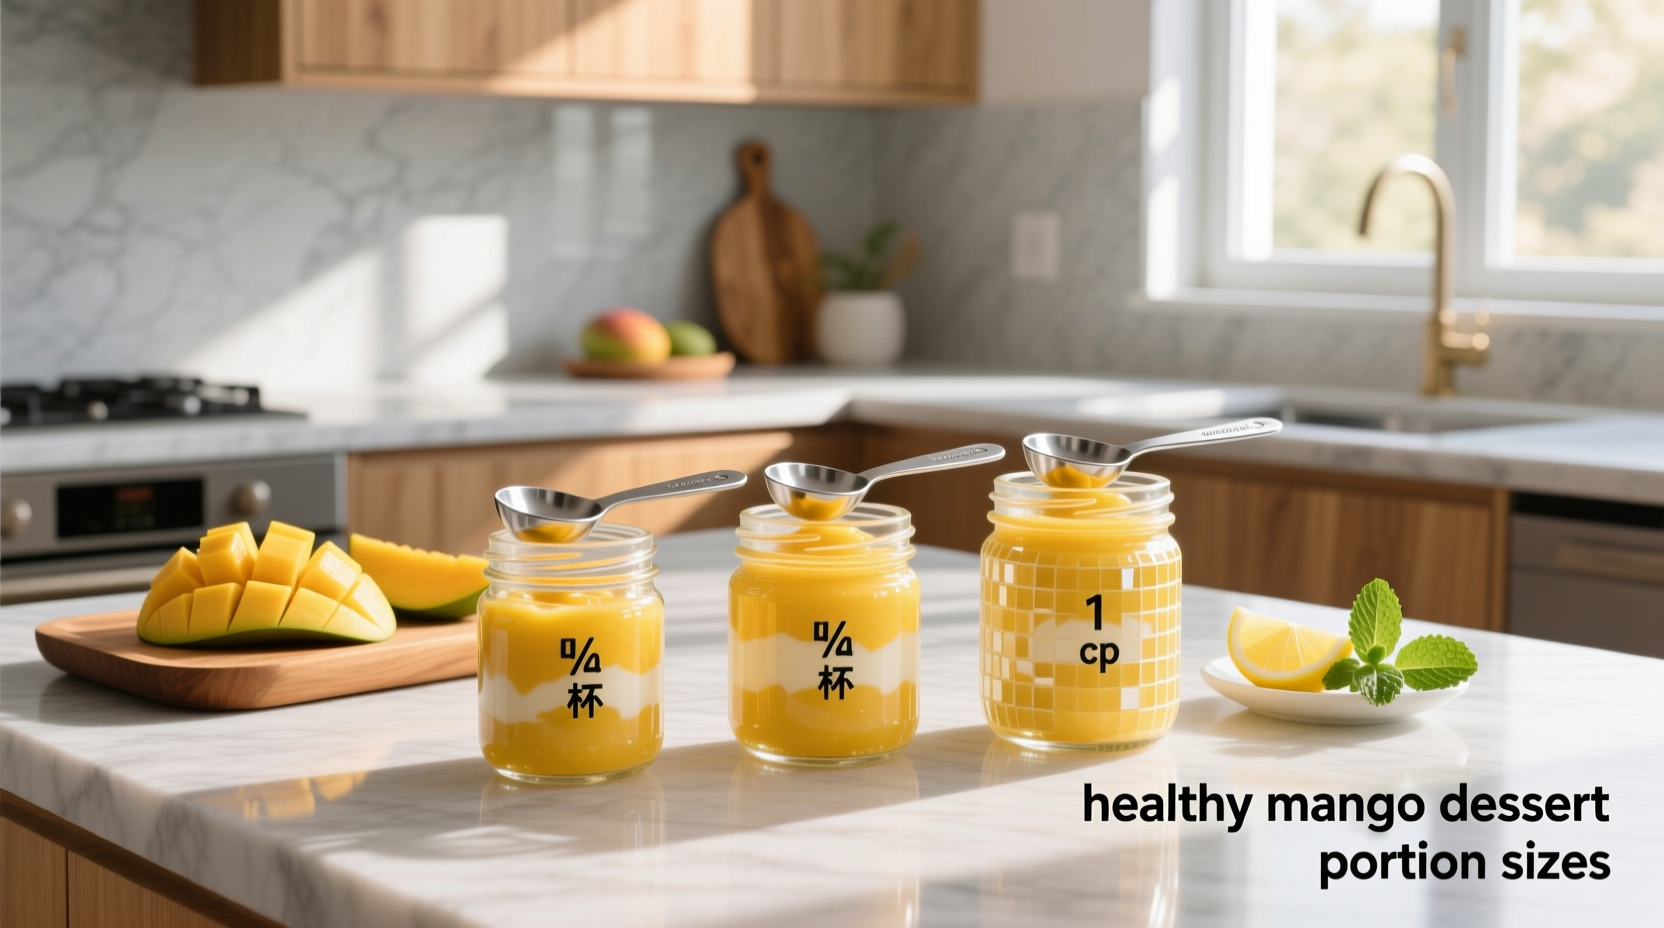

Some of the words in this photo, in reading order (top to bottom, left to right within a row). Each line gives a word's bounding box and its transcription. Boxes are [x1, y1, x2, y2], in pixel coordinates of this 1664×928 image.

[1085, 594, 1102, 631] 1
[1079, 642, 1120, 674] cp
[566, 682, 604, 719] 杯
[817, 664, 855, 701] 杯
